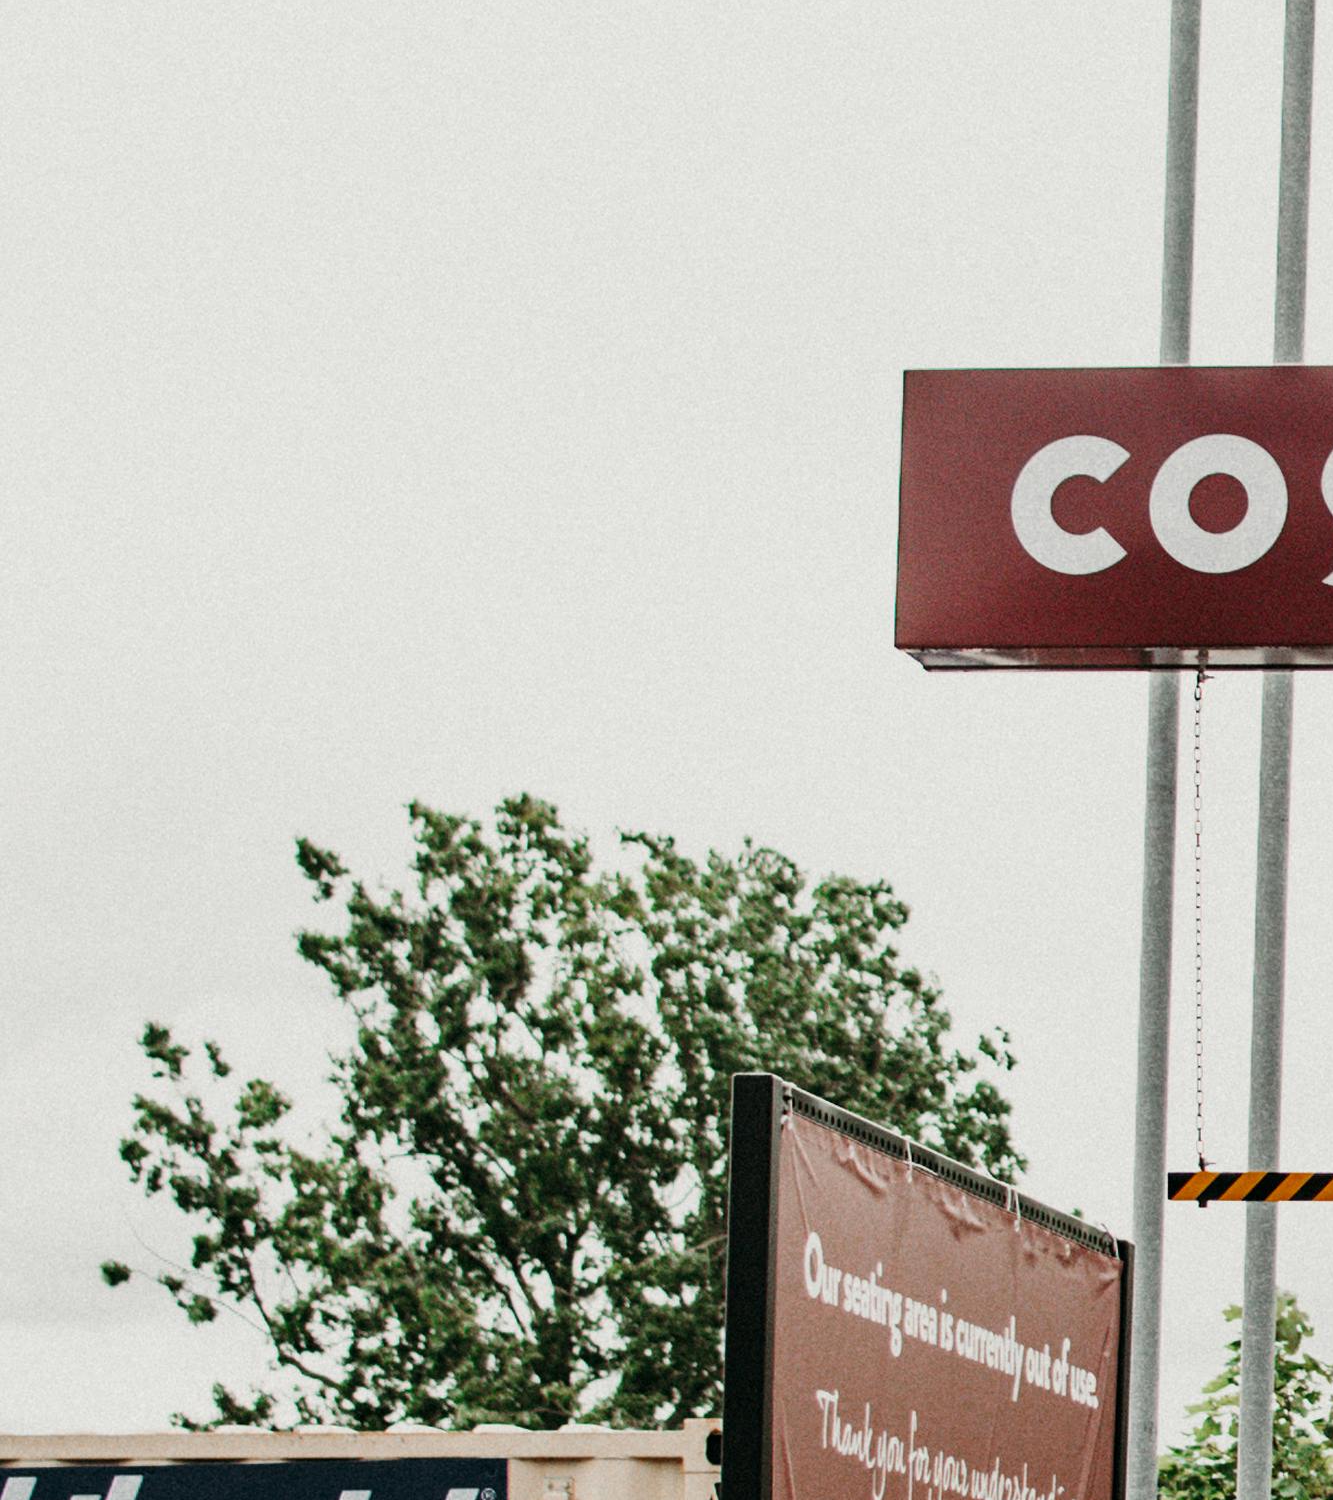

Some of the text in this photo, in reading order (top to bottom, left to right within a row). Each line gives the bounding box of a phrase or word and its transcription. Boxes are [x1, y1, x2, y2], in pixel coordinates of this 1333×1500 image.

[804, 1231, 842, 1306] Our
[843, 1261, 903, 1357] seating
[904, 1297, 937, 1346] area
[940, 1288, 954, 1351] is
[955, 1315, 1024, 1402] currently
[1025, 1343, 1051, 1390] out
[1052, 1337, 1071, 1397] of
[816, 1389, 875, 1468] Thank
